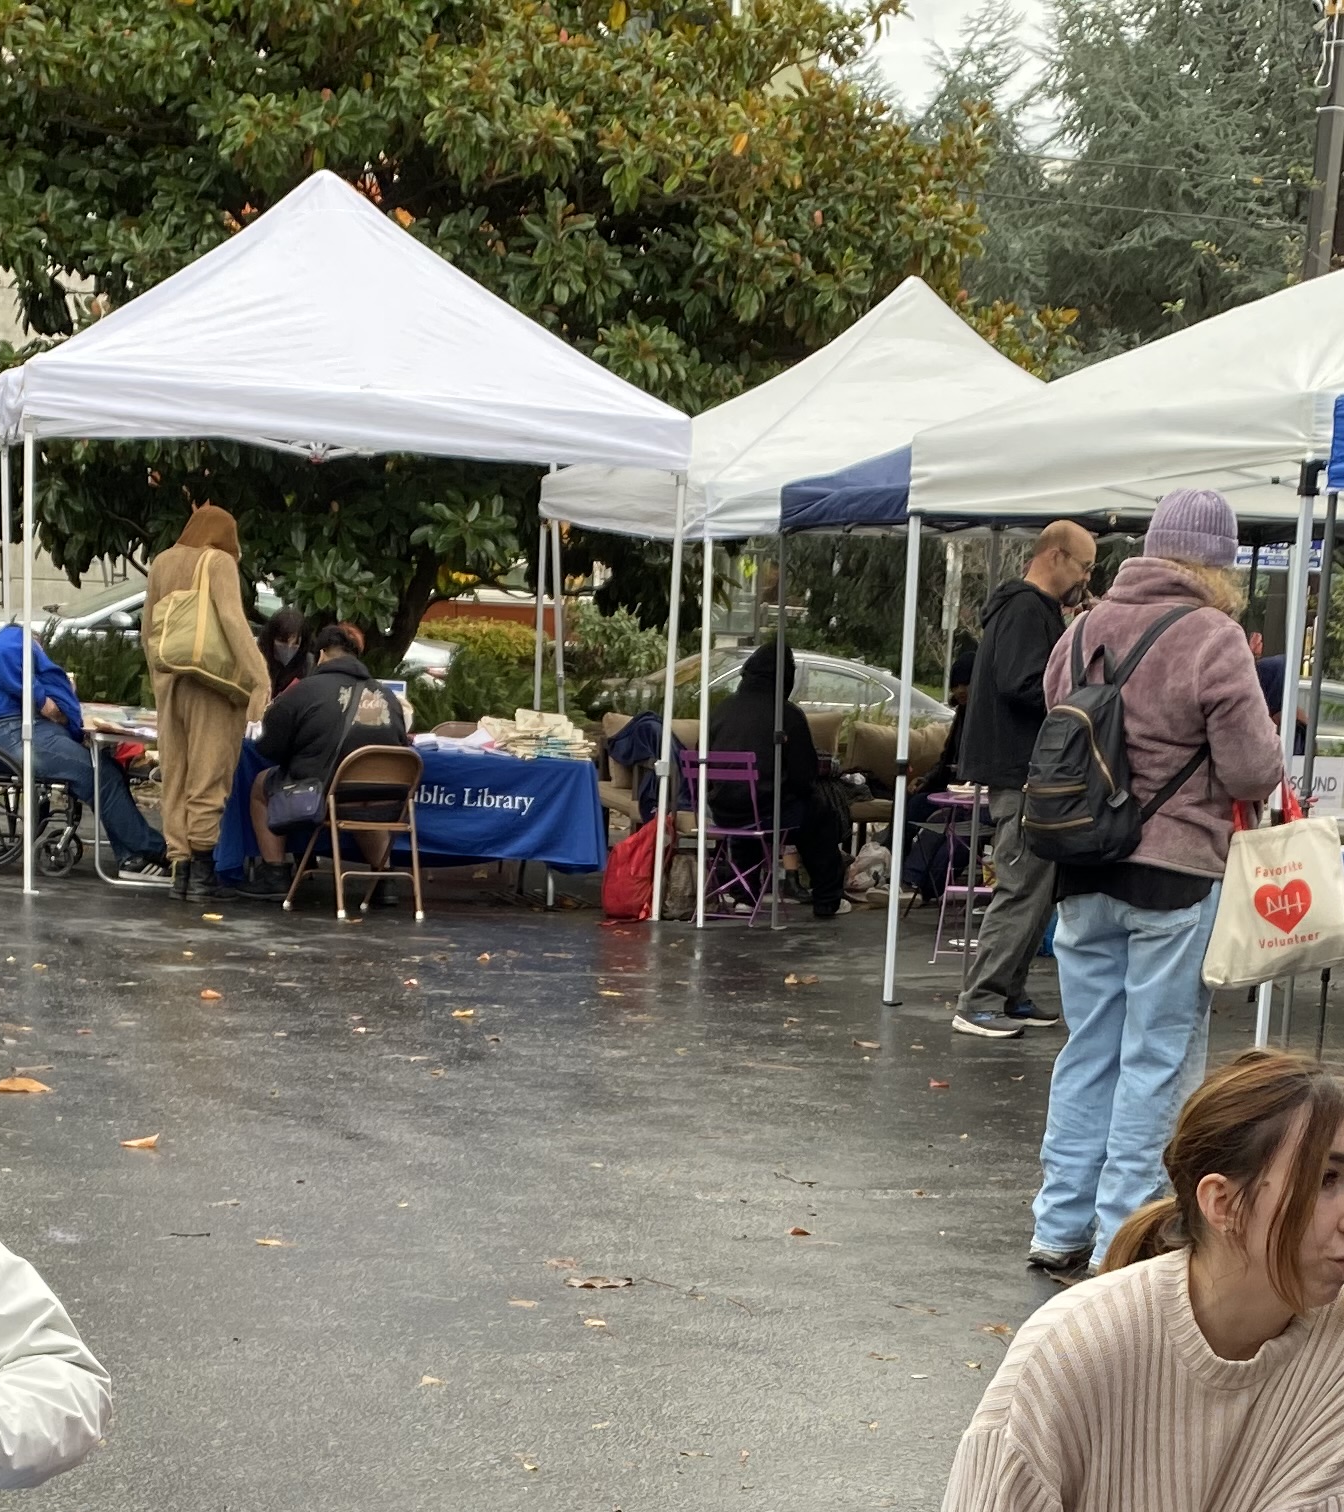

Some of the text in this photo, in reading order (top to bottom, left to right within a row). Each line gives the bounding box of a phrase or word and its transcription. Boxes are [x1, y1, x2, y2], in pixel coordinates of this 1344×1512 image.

[463, 787, 535, 816] Library
[1255, 861, 1303, 878] Favorite
[1259, 932, 1320, 949] Volunteer
